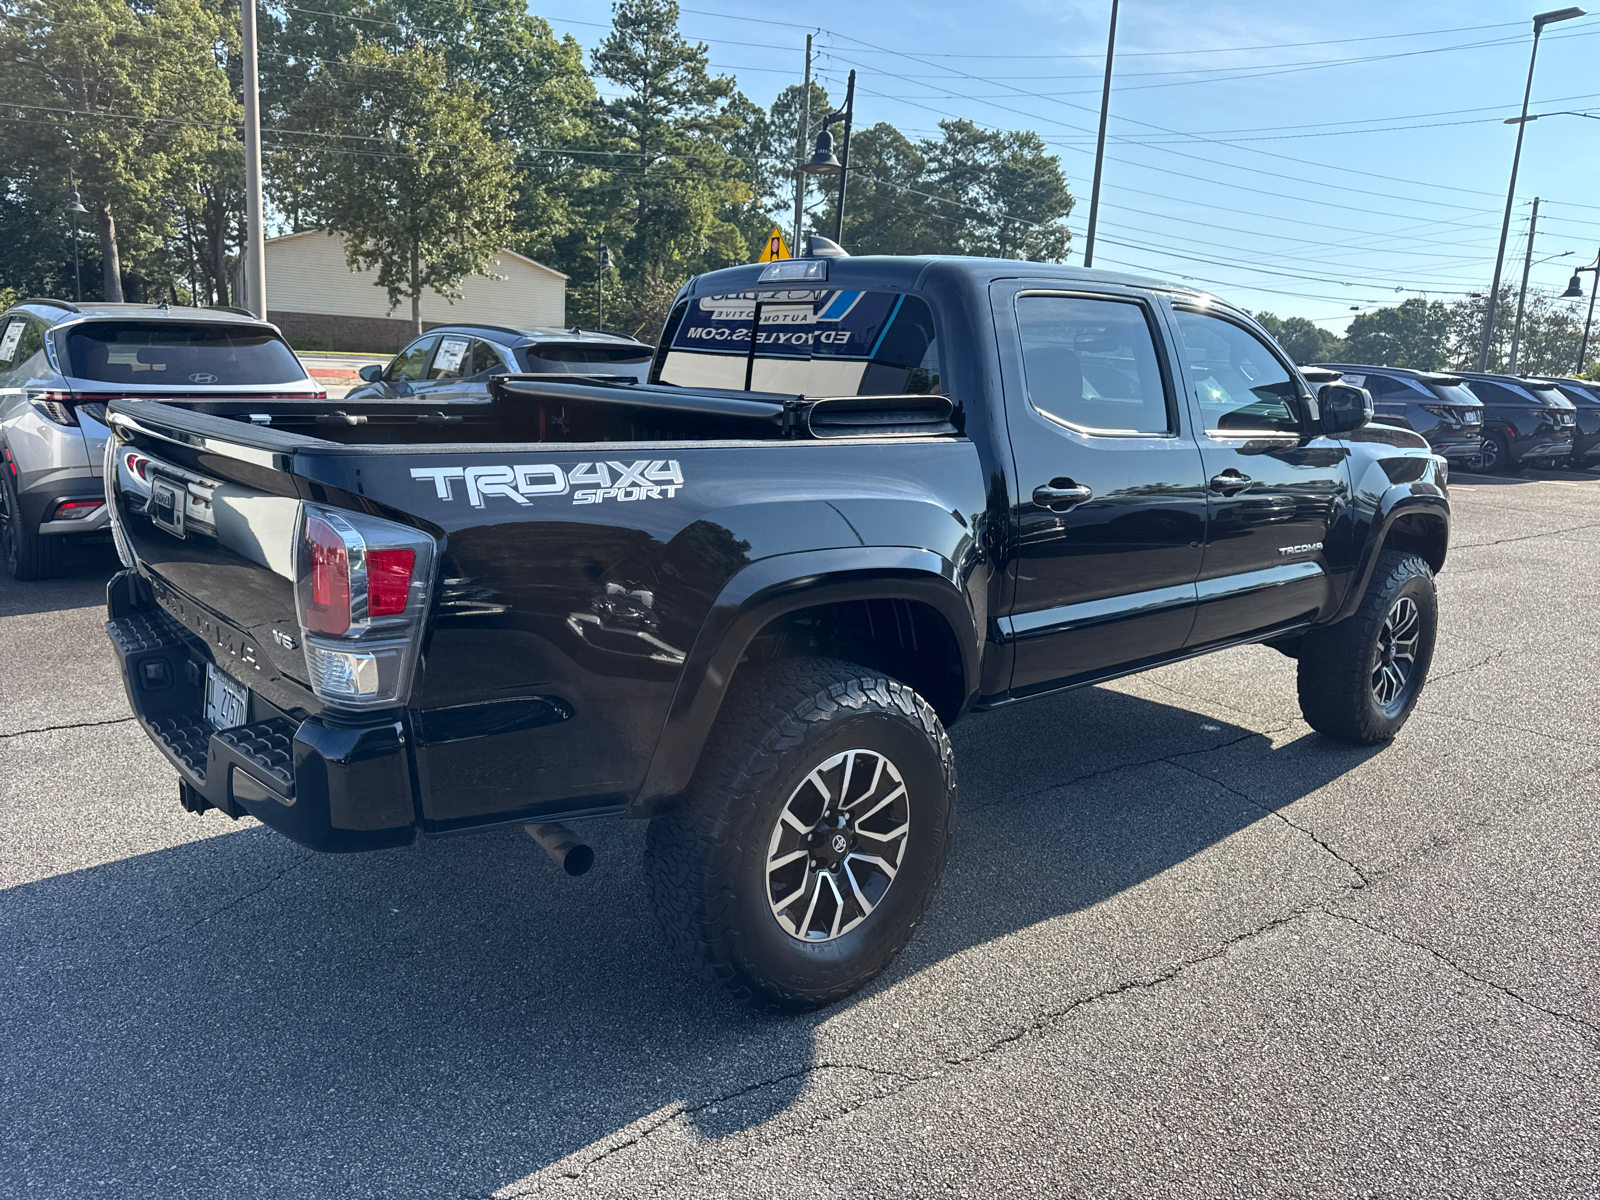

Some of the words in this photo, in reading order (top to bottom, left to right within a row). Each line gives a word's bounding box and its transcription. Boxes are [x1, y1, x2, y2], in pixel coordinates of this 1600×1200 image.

[410, 463, 570, 509] TRD
[568, 459, 685, 488] 4X4
[572, 484, 684, 505] SPORT
[1278, 541, 1324, 556] TACOMA
